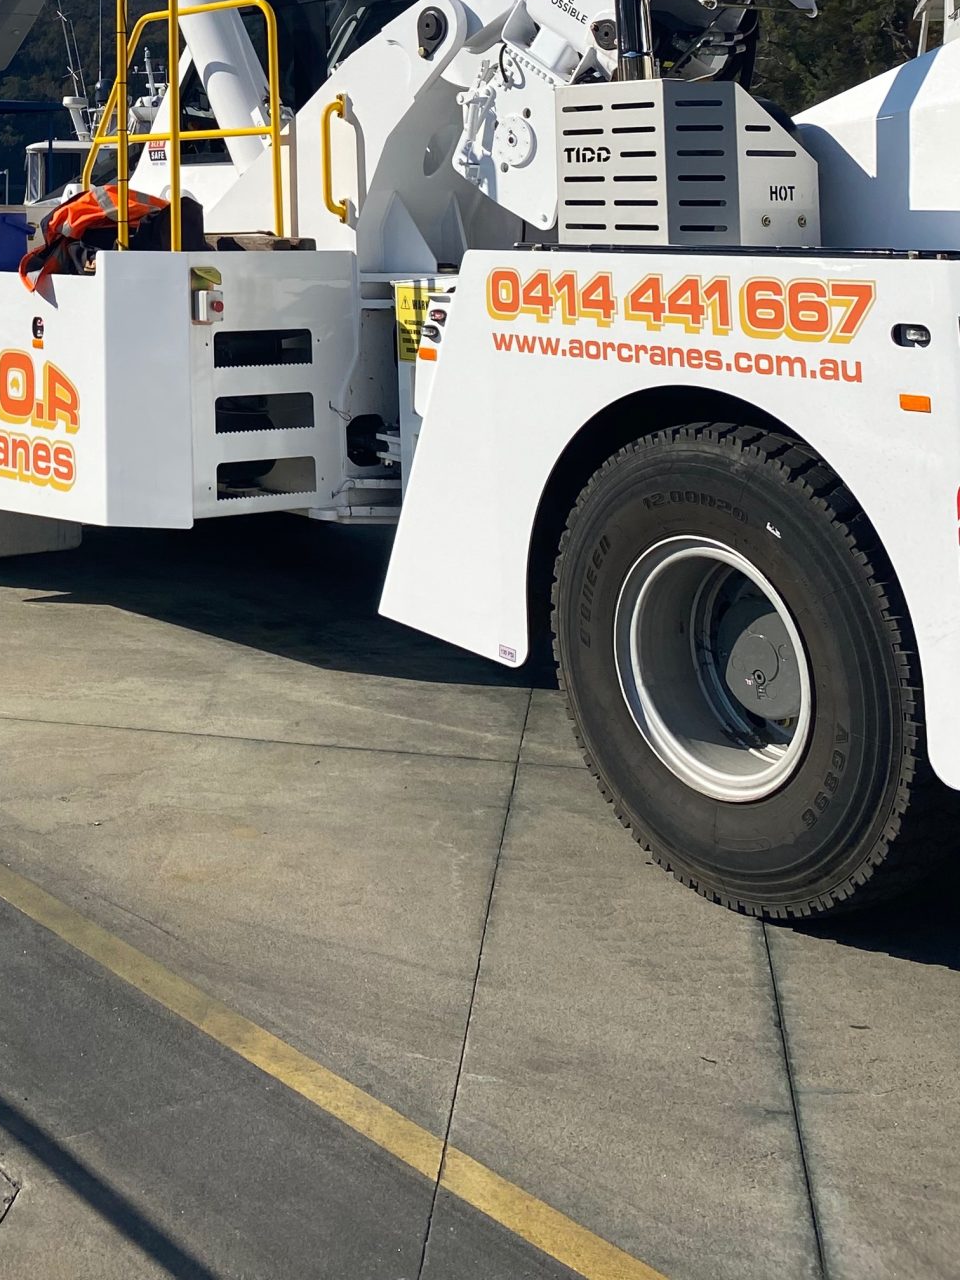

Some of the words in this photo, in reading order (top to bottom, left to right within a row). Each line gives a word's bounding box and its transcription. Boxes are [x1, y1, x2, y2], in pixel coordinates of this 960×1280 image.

[151, 151, 165, 160] SAFE
[563, 147, 611, 163] TIDD
[769, 185, 796, 202] HOT
[486, 267, 617, 328] 0414
[623, 273, 734, 337] 441
[739, 276, 877, 345] 667
[492, 332, 863, 384] www.aorcranes.com.au
